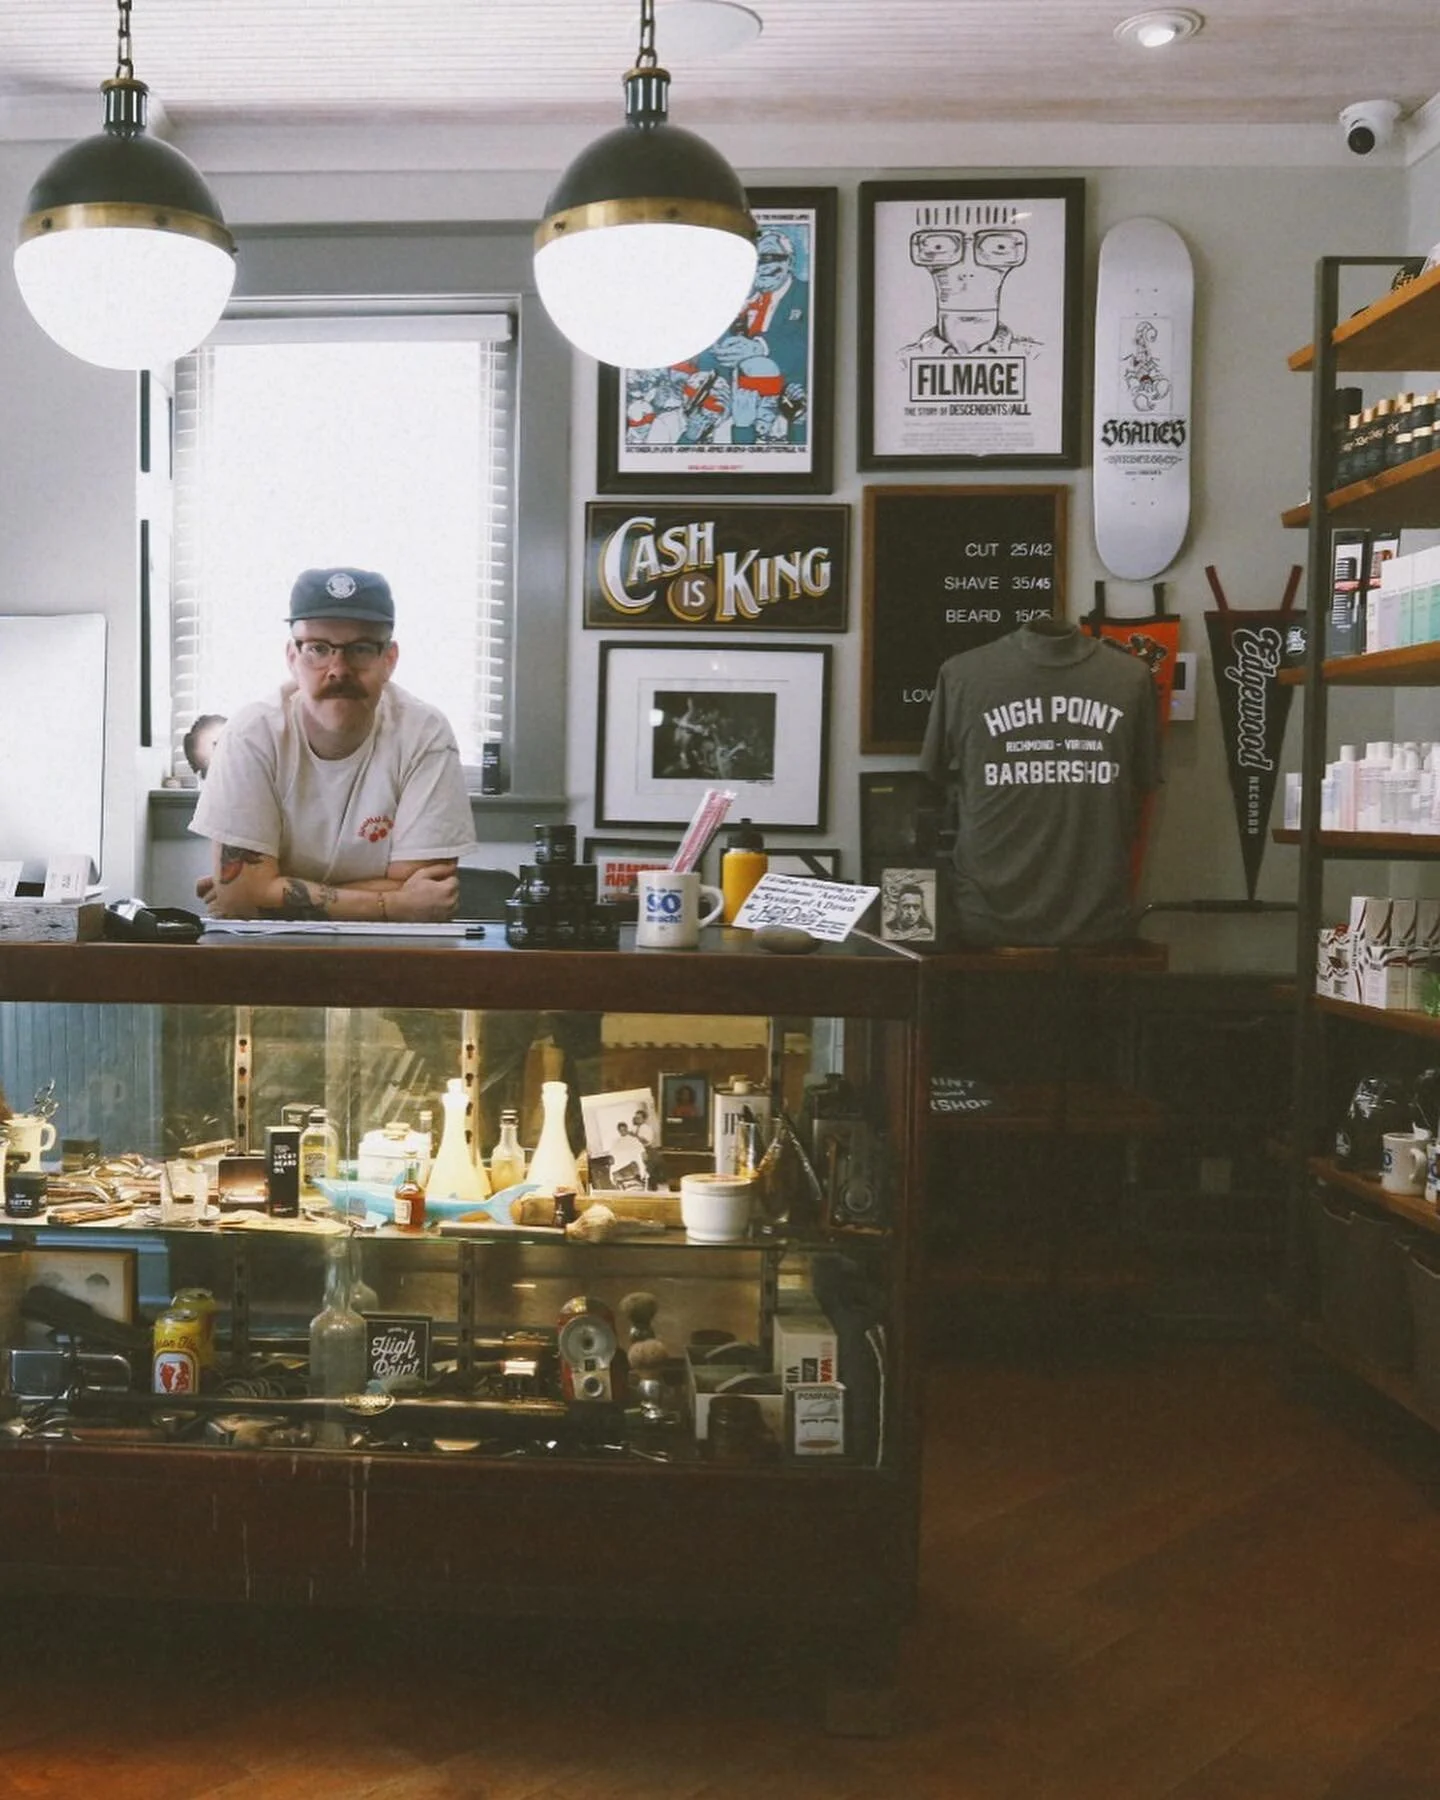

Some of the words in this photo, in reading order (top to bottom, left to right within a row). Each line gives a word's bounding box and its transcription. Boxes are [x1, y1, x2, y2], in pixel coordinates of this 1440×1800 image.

[917, 363, 1019, 396] FILMAGE
[904, 407, 917, 416] THE
[918, 407, 938, 416] STORY
[964, 543, 1000, 557] CUT
[1010, 543, 1053, 557] 25/42
[599, 516, 715, 613] CASH
[682, 580, 706, 607] IS
[716, 547, 831, 621] KING
[944, 576, 1000, 590] SHAVE
[1011, 576, 1052, 590] 35/45
[945, 609, 1001, 623] BEARD
[1225, 627, 1282, 770] Edgewood
[984, 697, 1044, 737] HIGH
[1051, 696, 1125, 734] POINT
[1005, 740, 1055, 752] RICHMOND
[1064, 739, 1104, 751] VIRGINIA
[984, 760, 1121, 786] BARBERSHOP
[371, 1331, 416, 1363] High
[373, 1358, 420, 1377] Point
